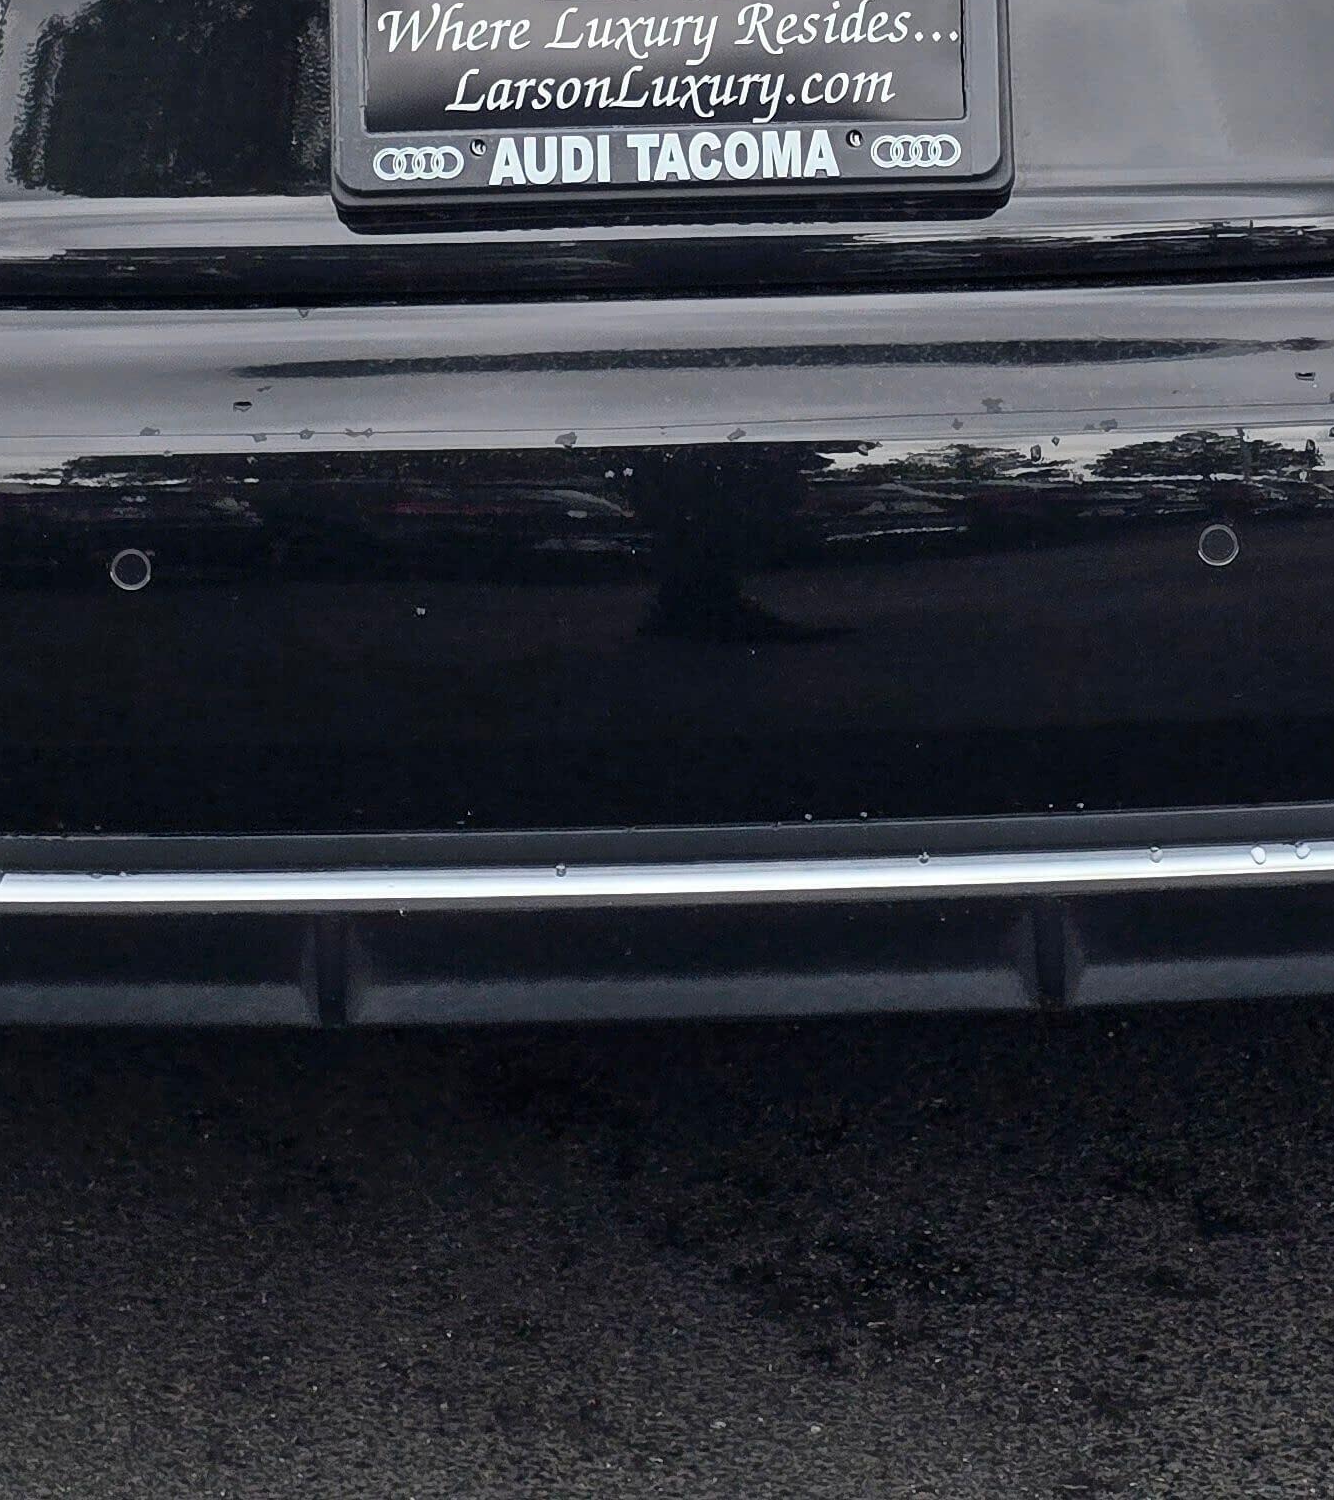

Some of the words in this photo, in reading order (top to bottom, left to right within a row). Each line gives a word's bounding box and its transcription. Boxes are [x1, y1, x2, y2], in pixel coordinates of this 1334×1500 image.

[377, 2, 531, 53] Where
[543, 6, 719, 66] Luxury
[444, 65, 896, 124] LarsonLuxury.com
[488, 134, 611, 186] AUDI
[626, 128, 841, 181] TACOMA
